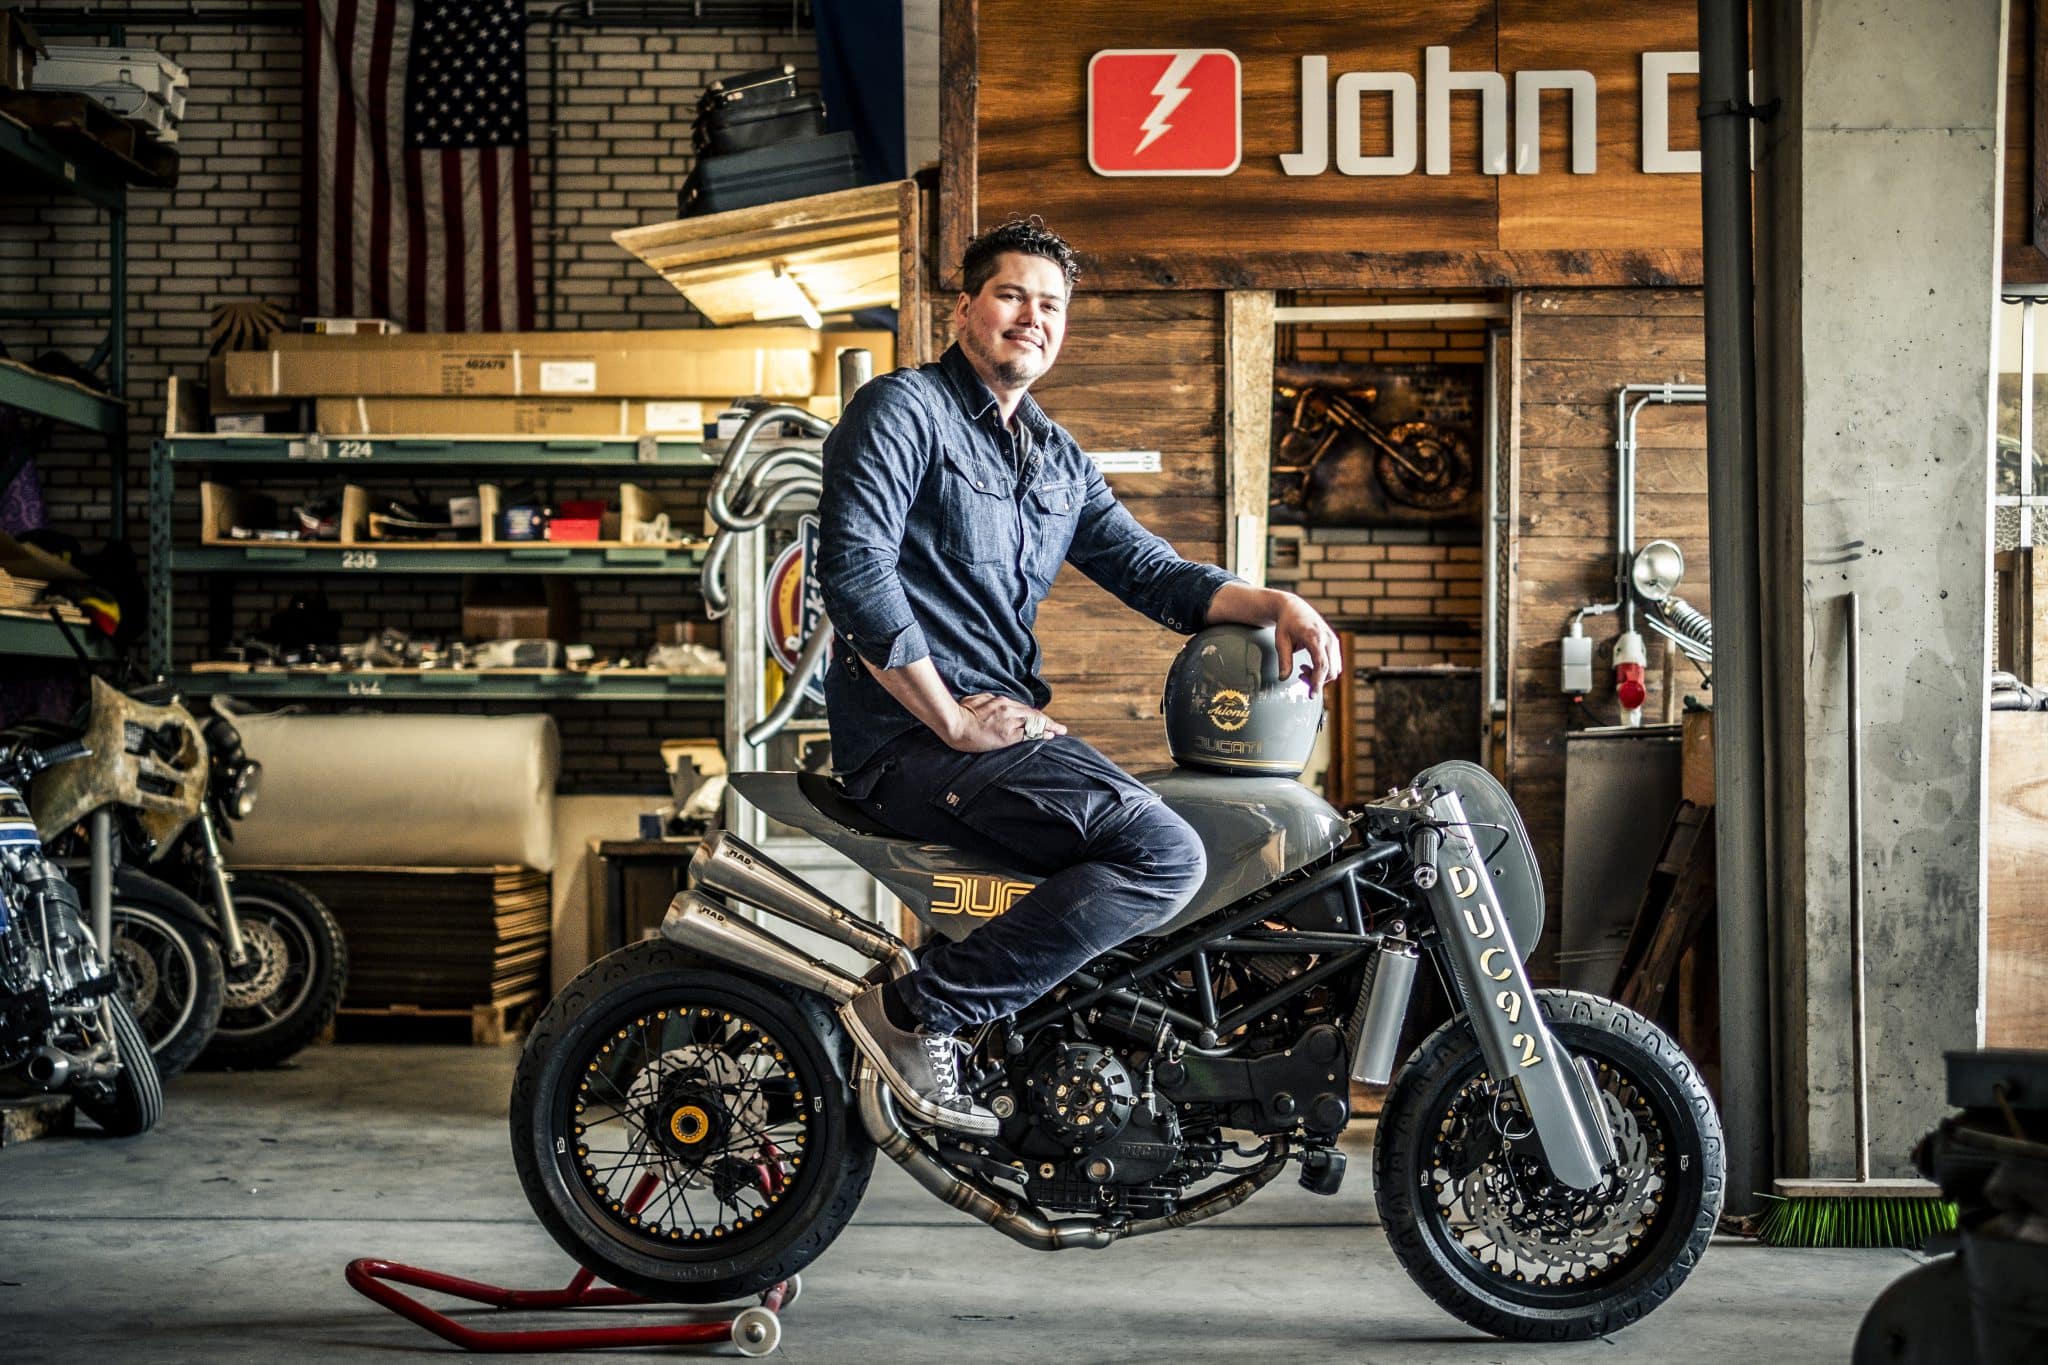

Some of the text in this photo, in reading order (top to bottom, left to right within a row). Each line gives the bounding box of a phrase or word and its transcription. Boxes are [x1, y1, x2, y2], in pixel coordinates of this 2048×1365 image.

[1279, 45, 1598, 176] John
[338, 441, 372, 459] 224
[342, 550, 378, 569] 235
[728, 848, 752, 866] MAD
[701, 906, 726, 923] MAD
[1448, 866, 1544, 1068] DUC92
